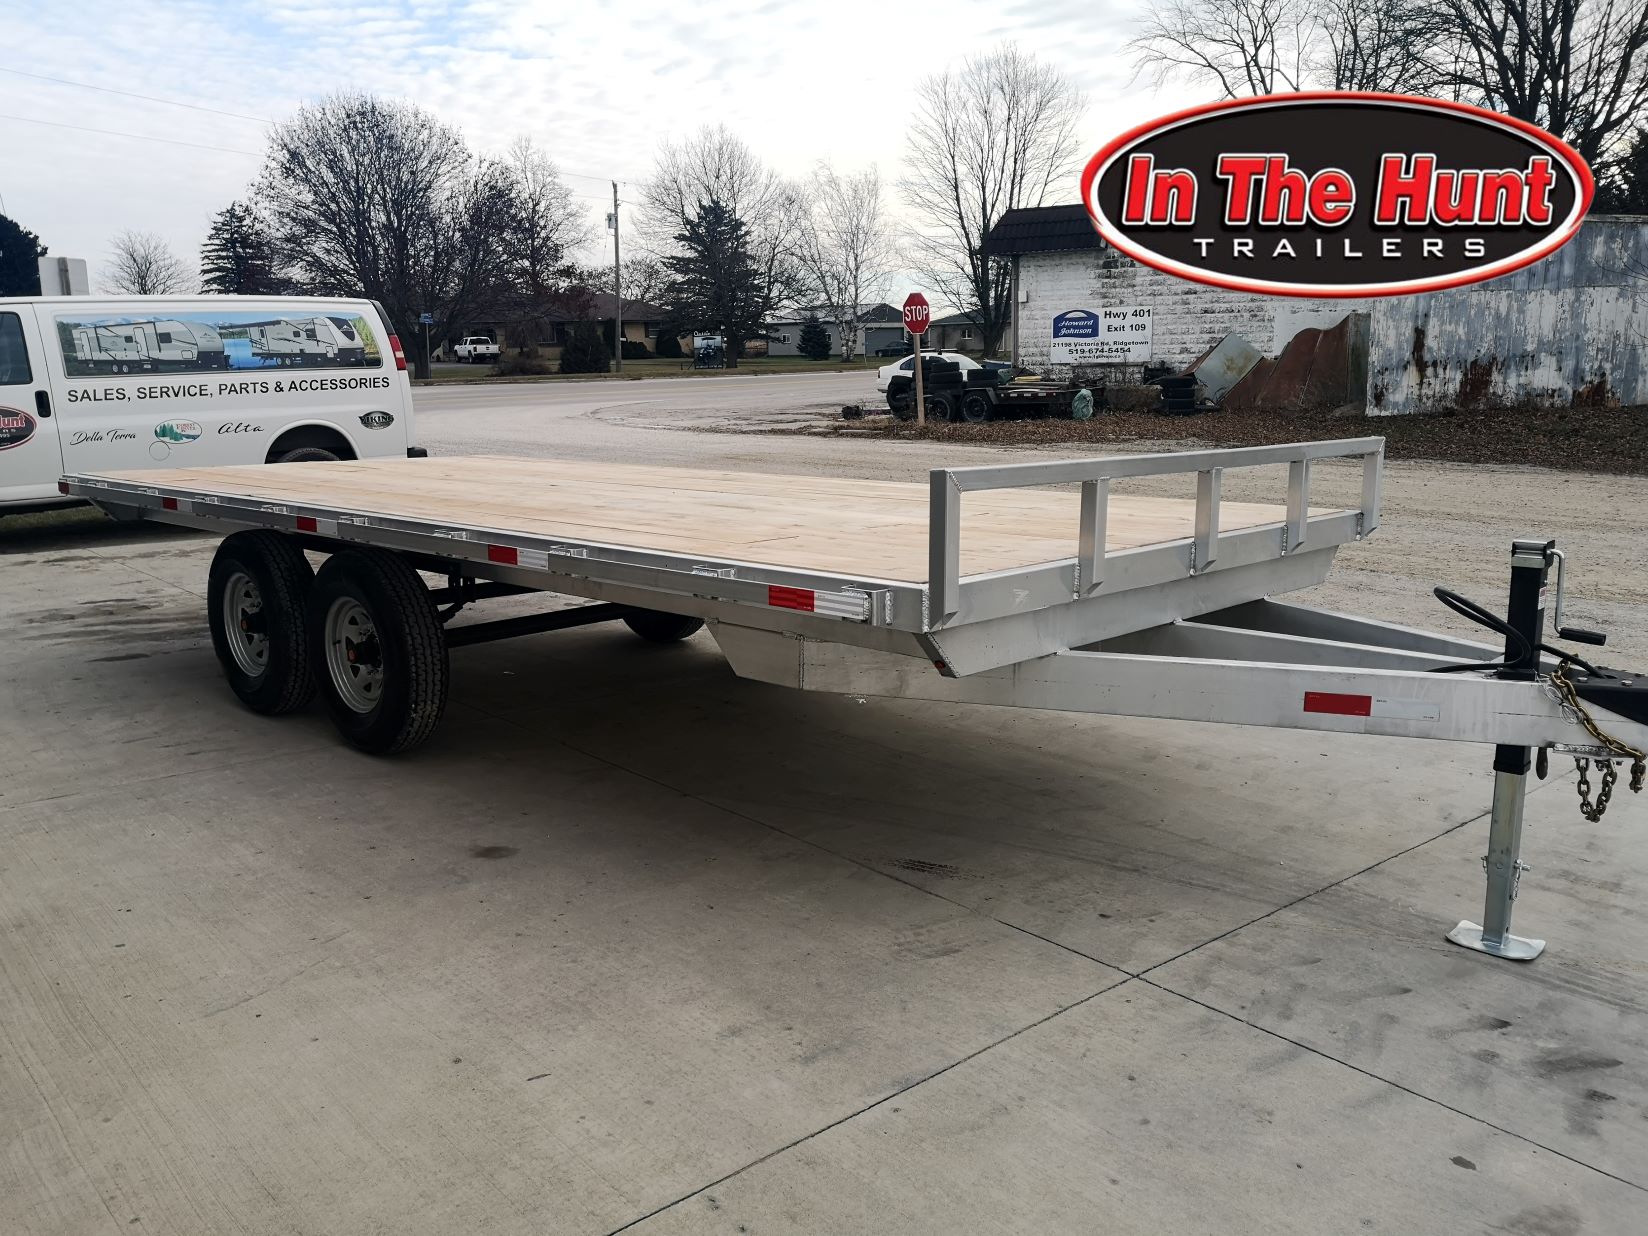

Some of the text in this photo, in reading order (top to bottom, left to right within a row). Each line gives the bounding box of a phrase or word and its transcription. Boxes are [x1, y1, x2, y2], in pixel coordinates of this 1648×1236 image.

[904, 305, 929, 321] STOP
[1104, 309, 1151, 320] Hwy 401
[1059, 328, 1093, 336] Johnson
[1107, 323, 1146, 332] Exit 109
[1068, 347, 1132, 355] 519-674-5454
[67, 376, 390, 403] SALES, SERVICE, PARTS & ACCESSORIES
[217, 422, 264, 435] Alta
[69, 428, 136, 446] Della Terra
